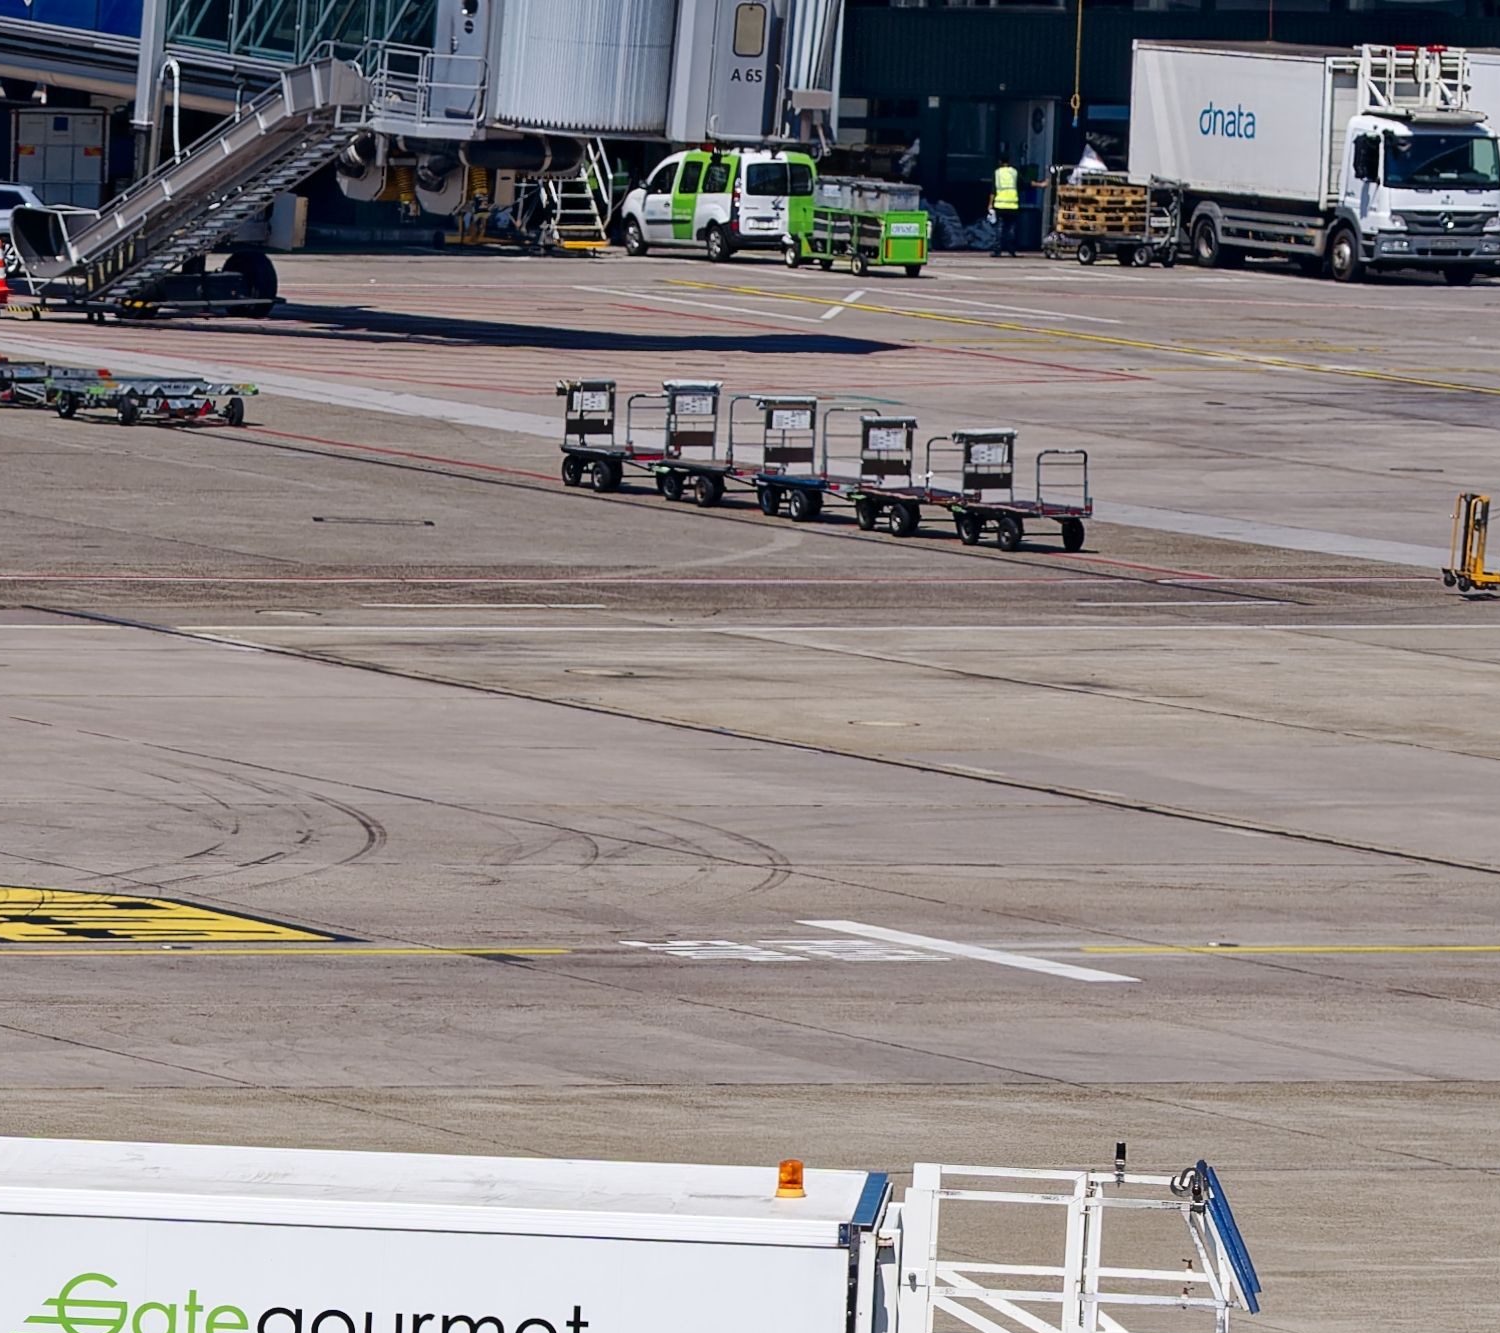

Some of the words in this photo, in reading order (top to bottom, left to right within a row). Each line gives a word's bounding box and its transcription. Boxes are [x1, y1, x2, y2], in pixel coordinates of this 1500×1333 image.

[731, 68, 741, 81] A
[746, 68, 762, 82] 65
[1199, 101, 1255, 138] dnata
